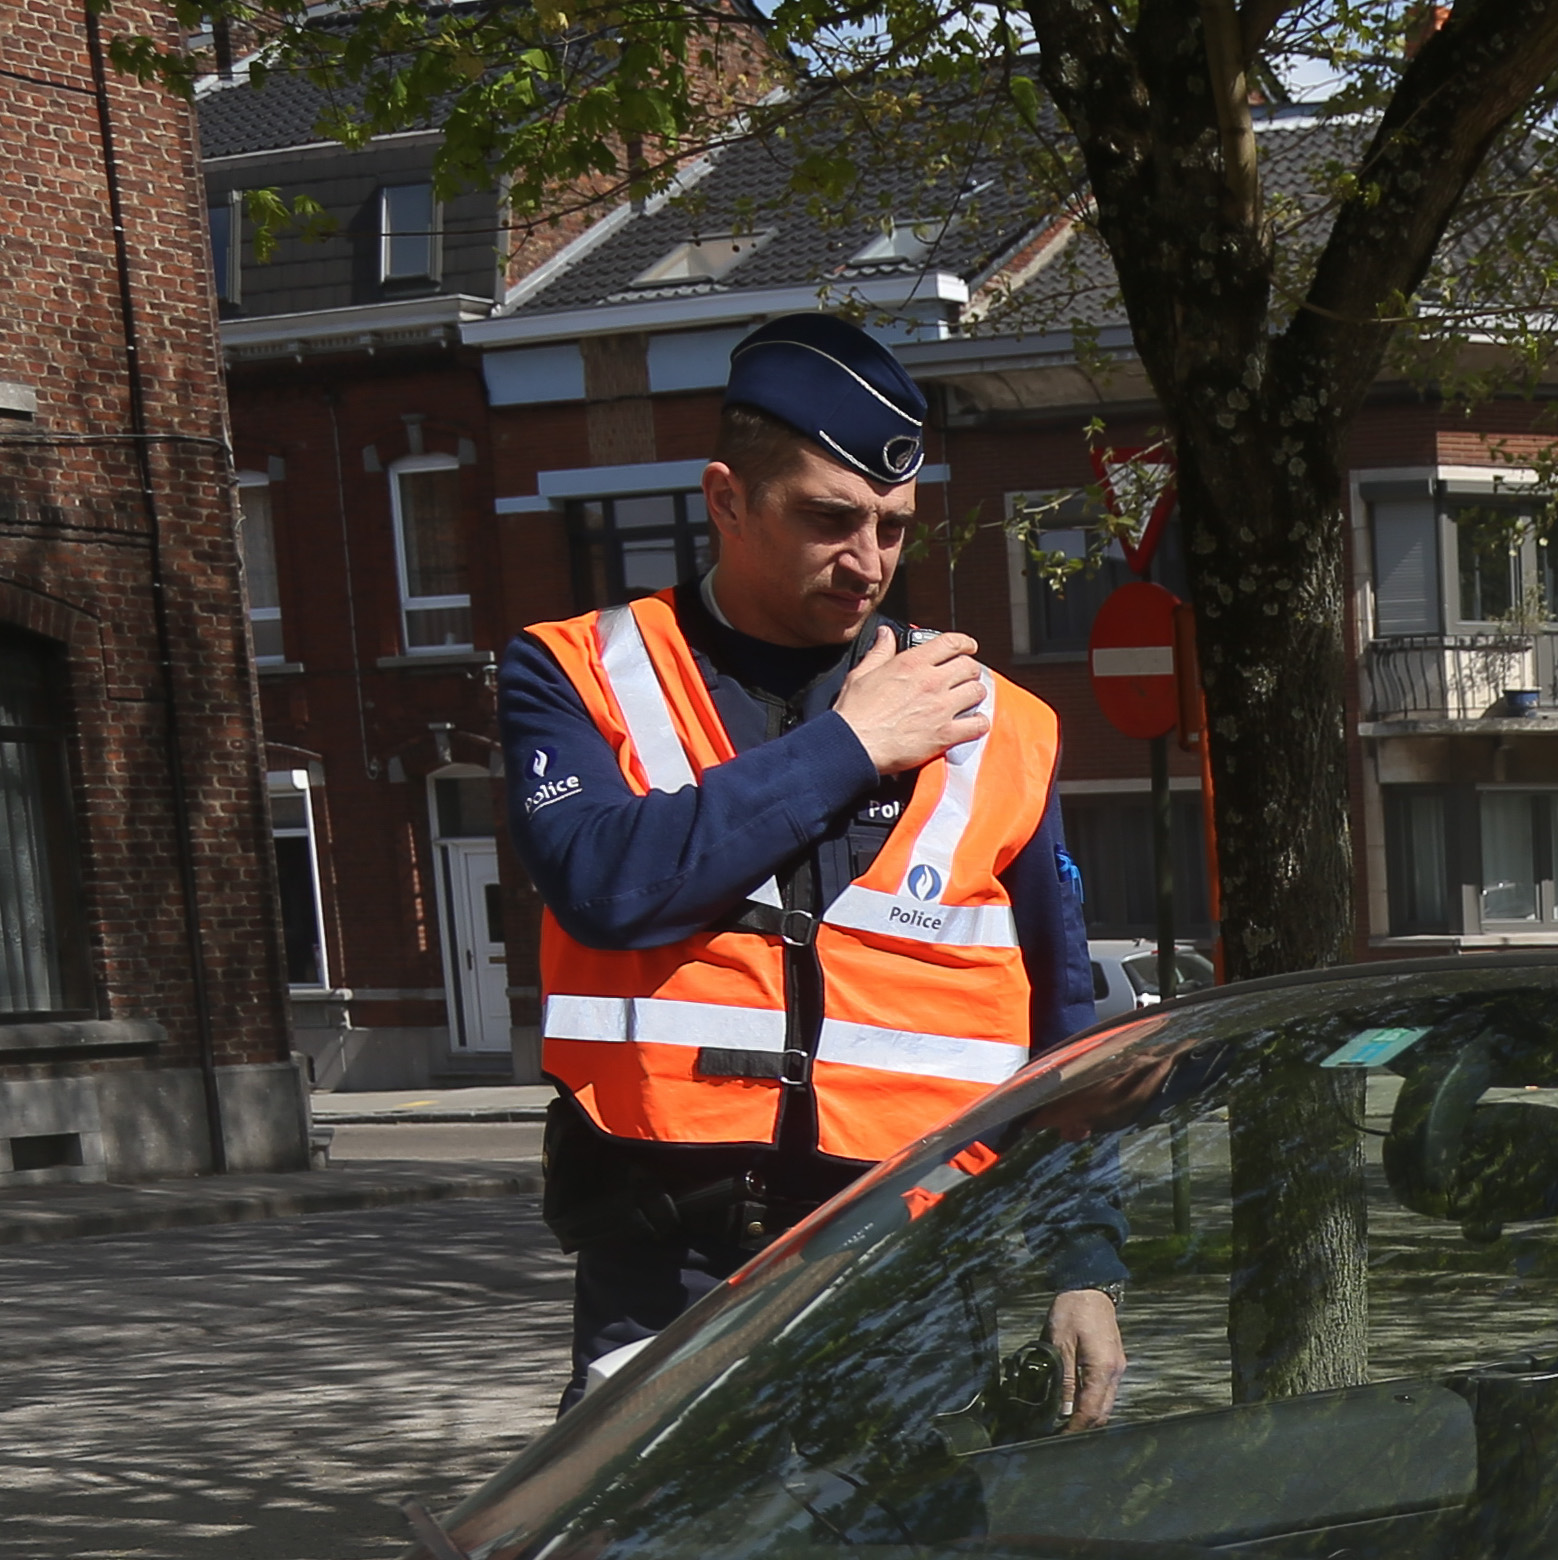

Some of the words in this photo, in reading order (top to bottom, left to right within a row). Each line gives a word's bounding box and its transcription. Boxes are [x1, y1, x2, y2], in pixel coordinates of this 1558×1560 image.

[524, 775, 580, 814] Police
[869, 799, 905, 819] Pol
[889, 906, 943, 931] Police
